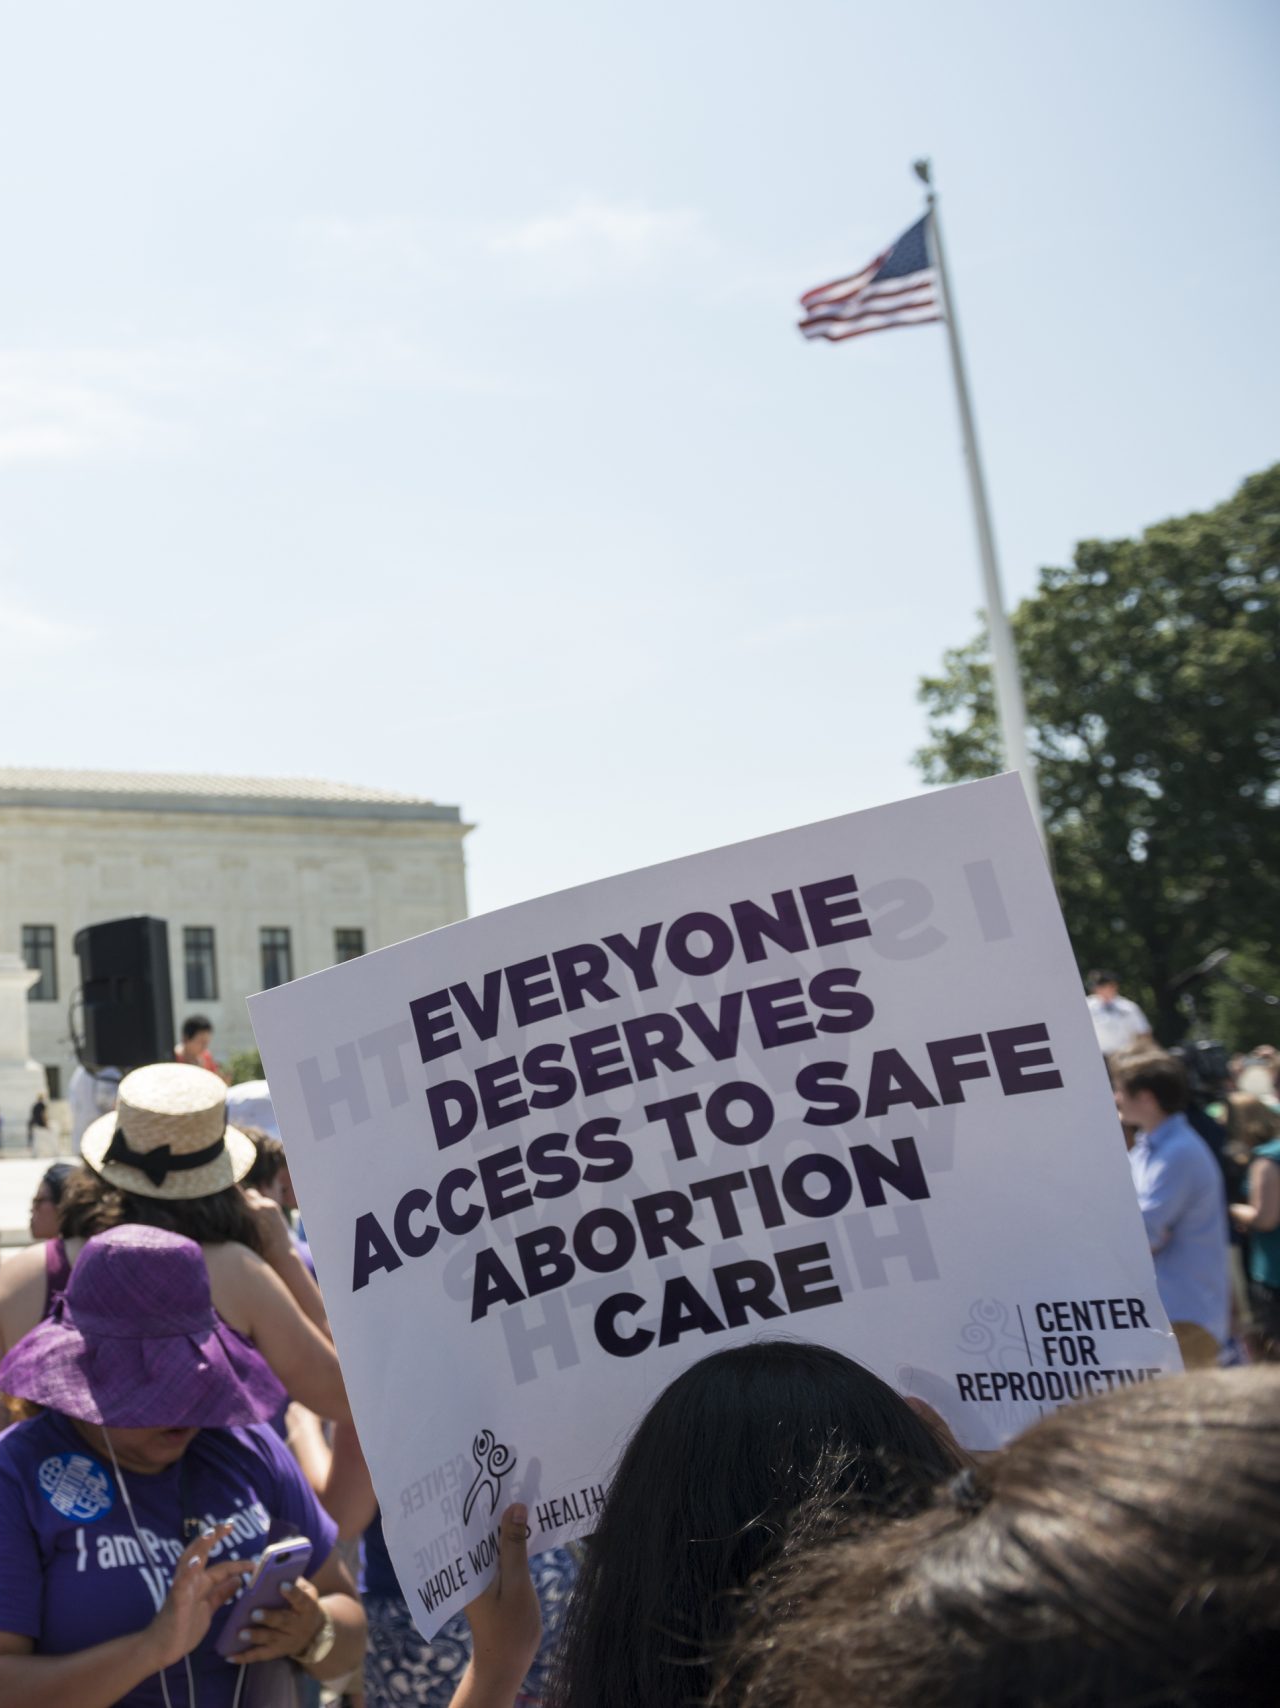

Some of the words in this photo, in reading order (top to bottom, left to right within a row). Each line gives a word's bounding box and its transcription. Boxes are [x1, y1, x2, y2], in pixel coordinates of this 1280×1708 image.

[409, 874, 872, 1064] EVERYONE
[425, 967, 875, 1151] DESERVES
[352, 1116, 634, 1292] ACCESS
[644, 1080, 775, 1162] TO
[795, 1022, 1064, 1127] SAFE
[471, 1136, 931, 1323] ABORTION
[594, 1241, 843, 1358] CARE
[1035, 1298, 1151, 1333] CENTER
[1042, 1335, 1100, 1367] FOR
[76, 1527, 87, 1572] I
[96, 1535, 143, 1570] am
[417, 1557, 468, 1614] WHOLE
[536, 1484, 609, 1532] HEALTH
